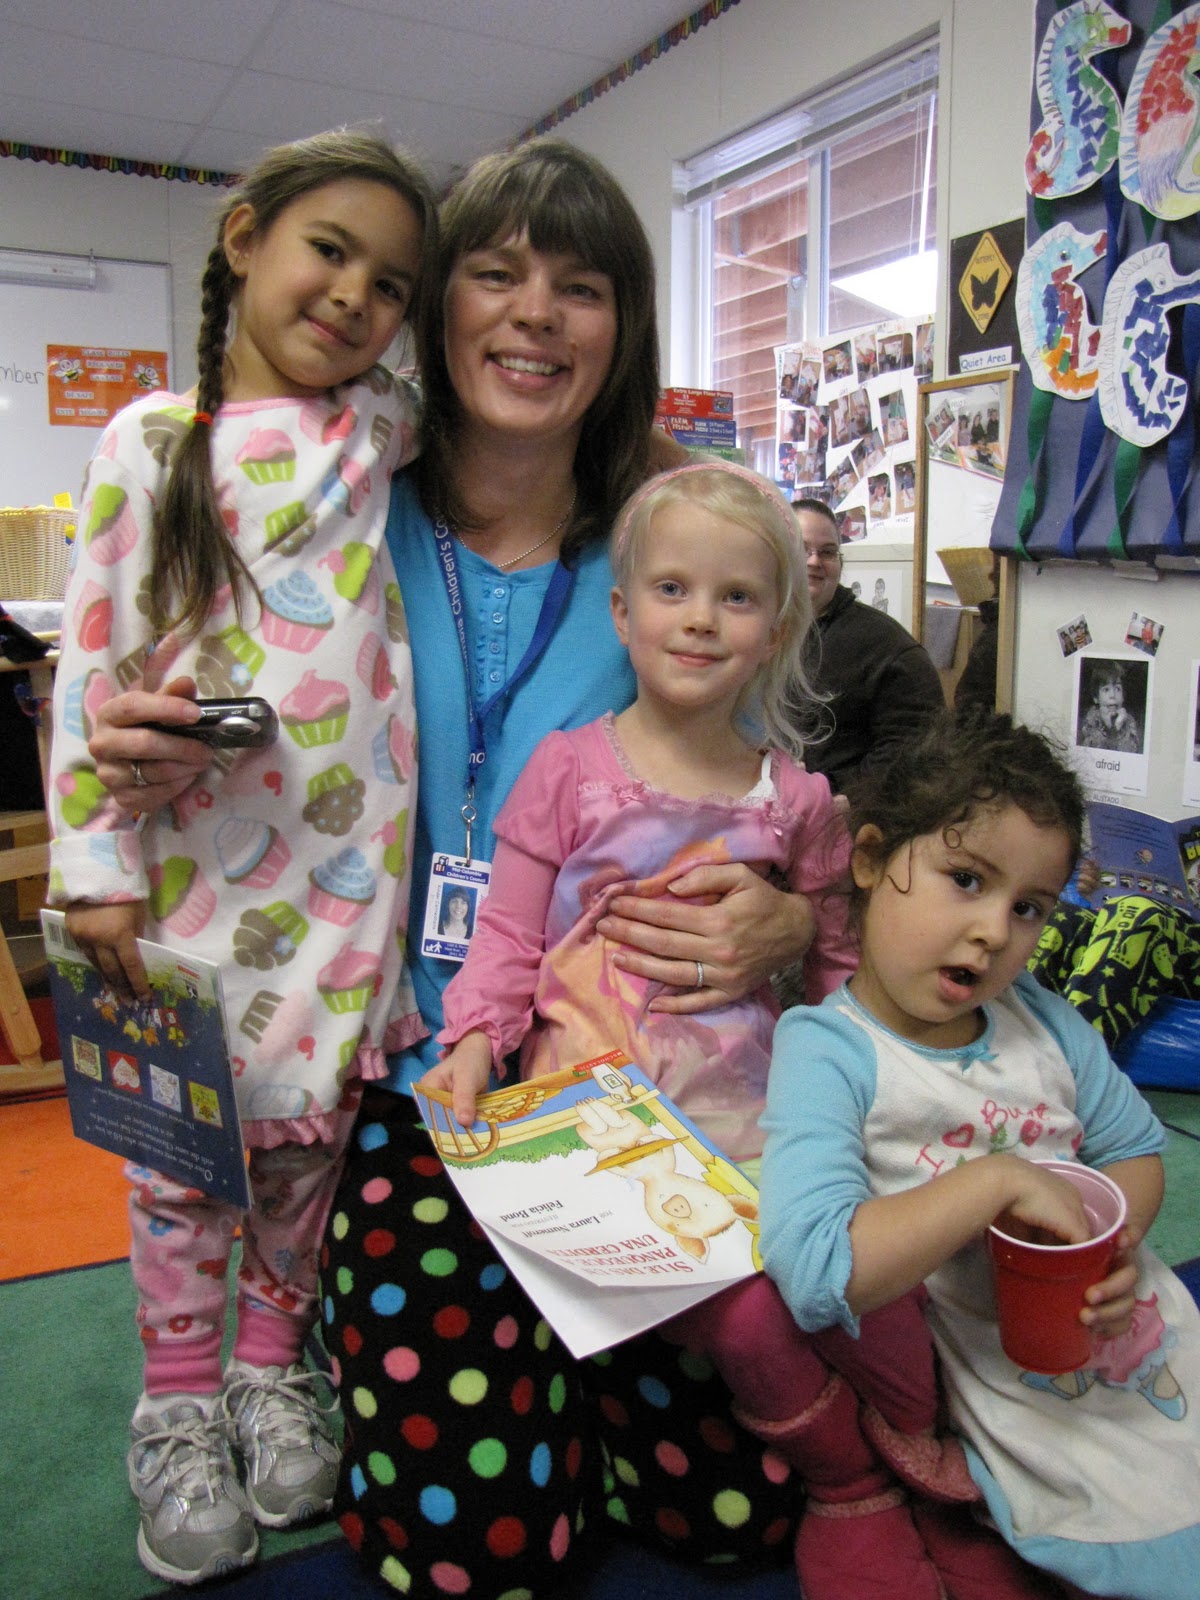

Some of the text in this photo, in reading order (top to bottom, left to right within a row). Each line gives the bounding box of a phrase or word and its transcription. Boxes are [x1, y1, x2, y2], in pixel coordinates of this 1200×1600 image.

[961, 354, 1006, 370] Quiet Area
[440, 541, 462, 615] Children's
[1095, 758, 1120, 771] afraid
[499, 1199, 564, 1223] Felicia Bond
[569, 1215, 601, 1229] Laura
[522, 1224, 571, 1238] Numeroff
[546, 1234, 660, 1257] UNA CERDITA
[582, 1247, 678, 1266] PANQUEQUE
[643, 1264, 670, 1274] LE
[665, 1261, 694, 1273] SI
